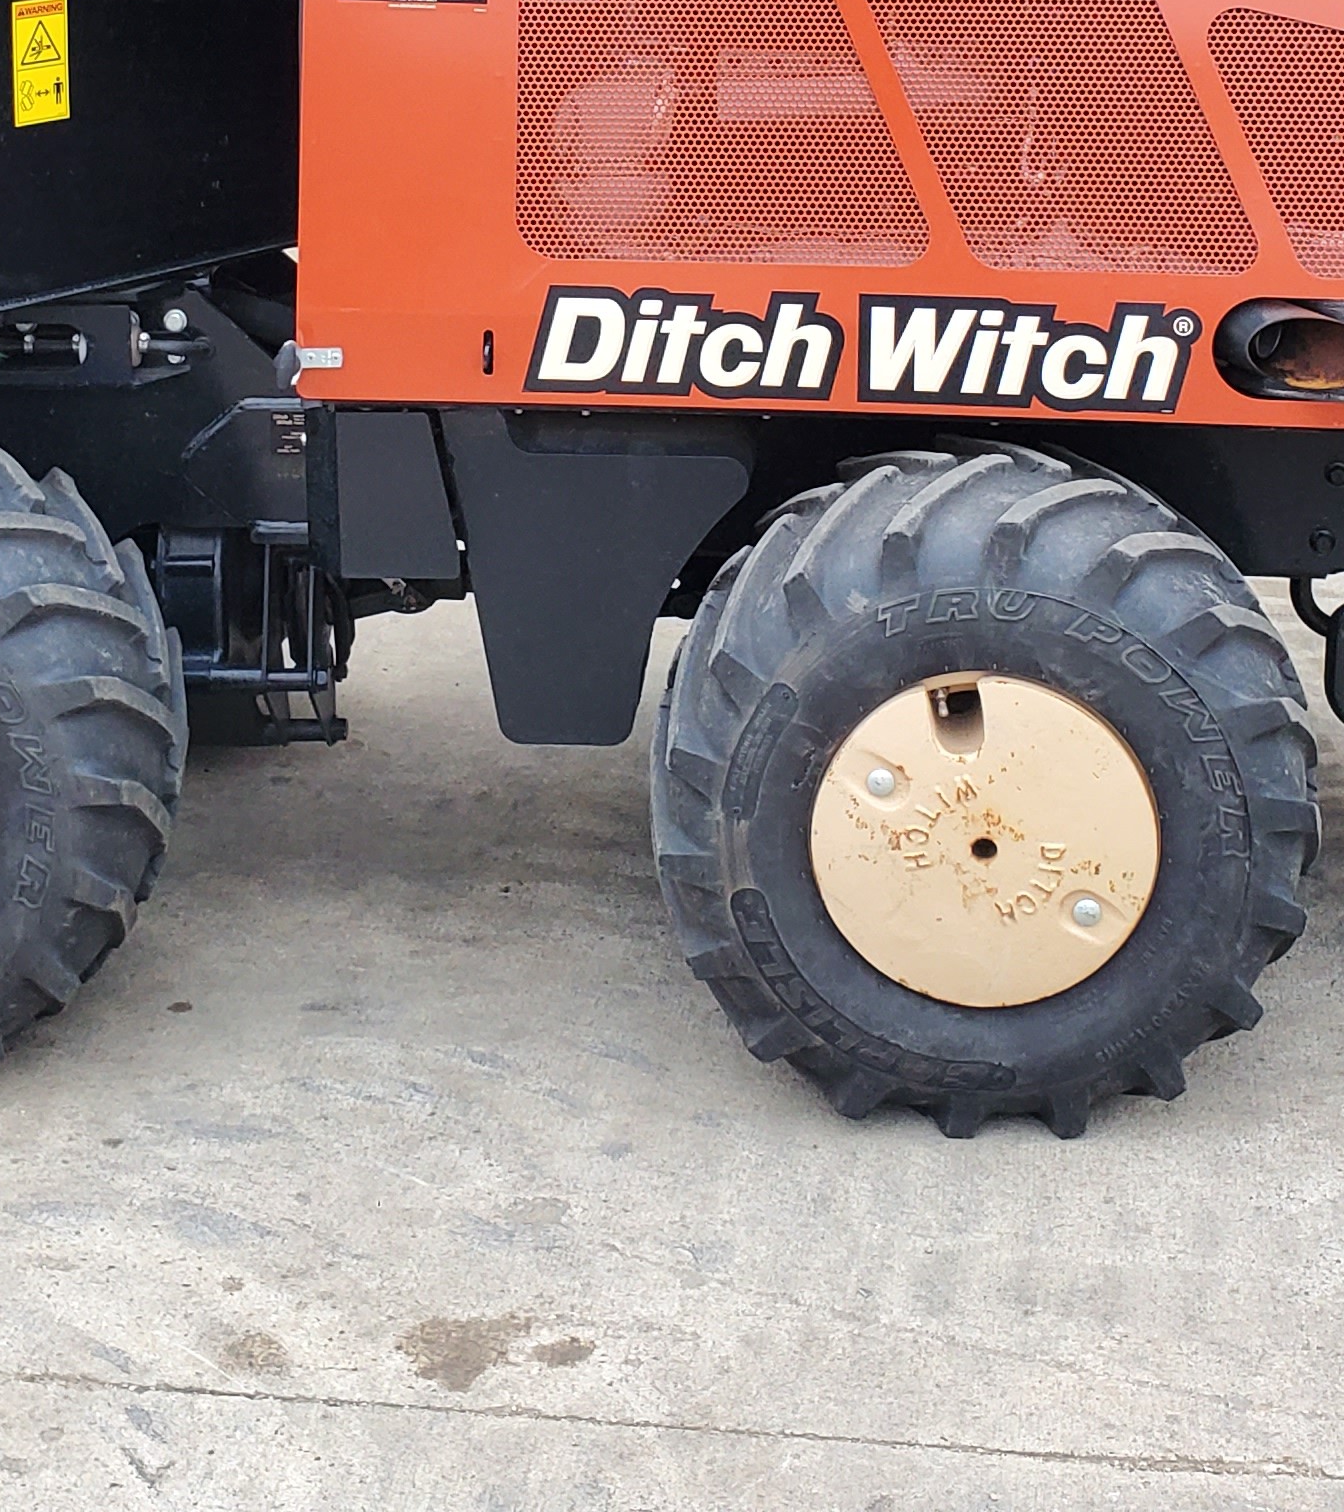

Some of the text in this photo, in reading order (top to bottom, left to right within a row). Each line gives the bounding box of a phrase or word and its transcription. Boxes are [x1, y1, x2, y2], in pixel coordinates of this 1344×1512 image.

[24, 3, 63, 16] WARNING
[537, 295, 837, 390] Ditch
[876, 588, 1253, 862] TRU POWER
[993, 841, 1068, 926] DITCH
